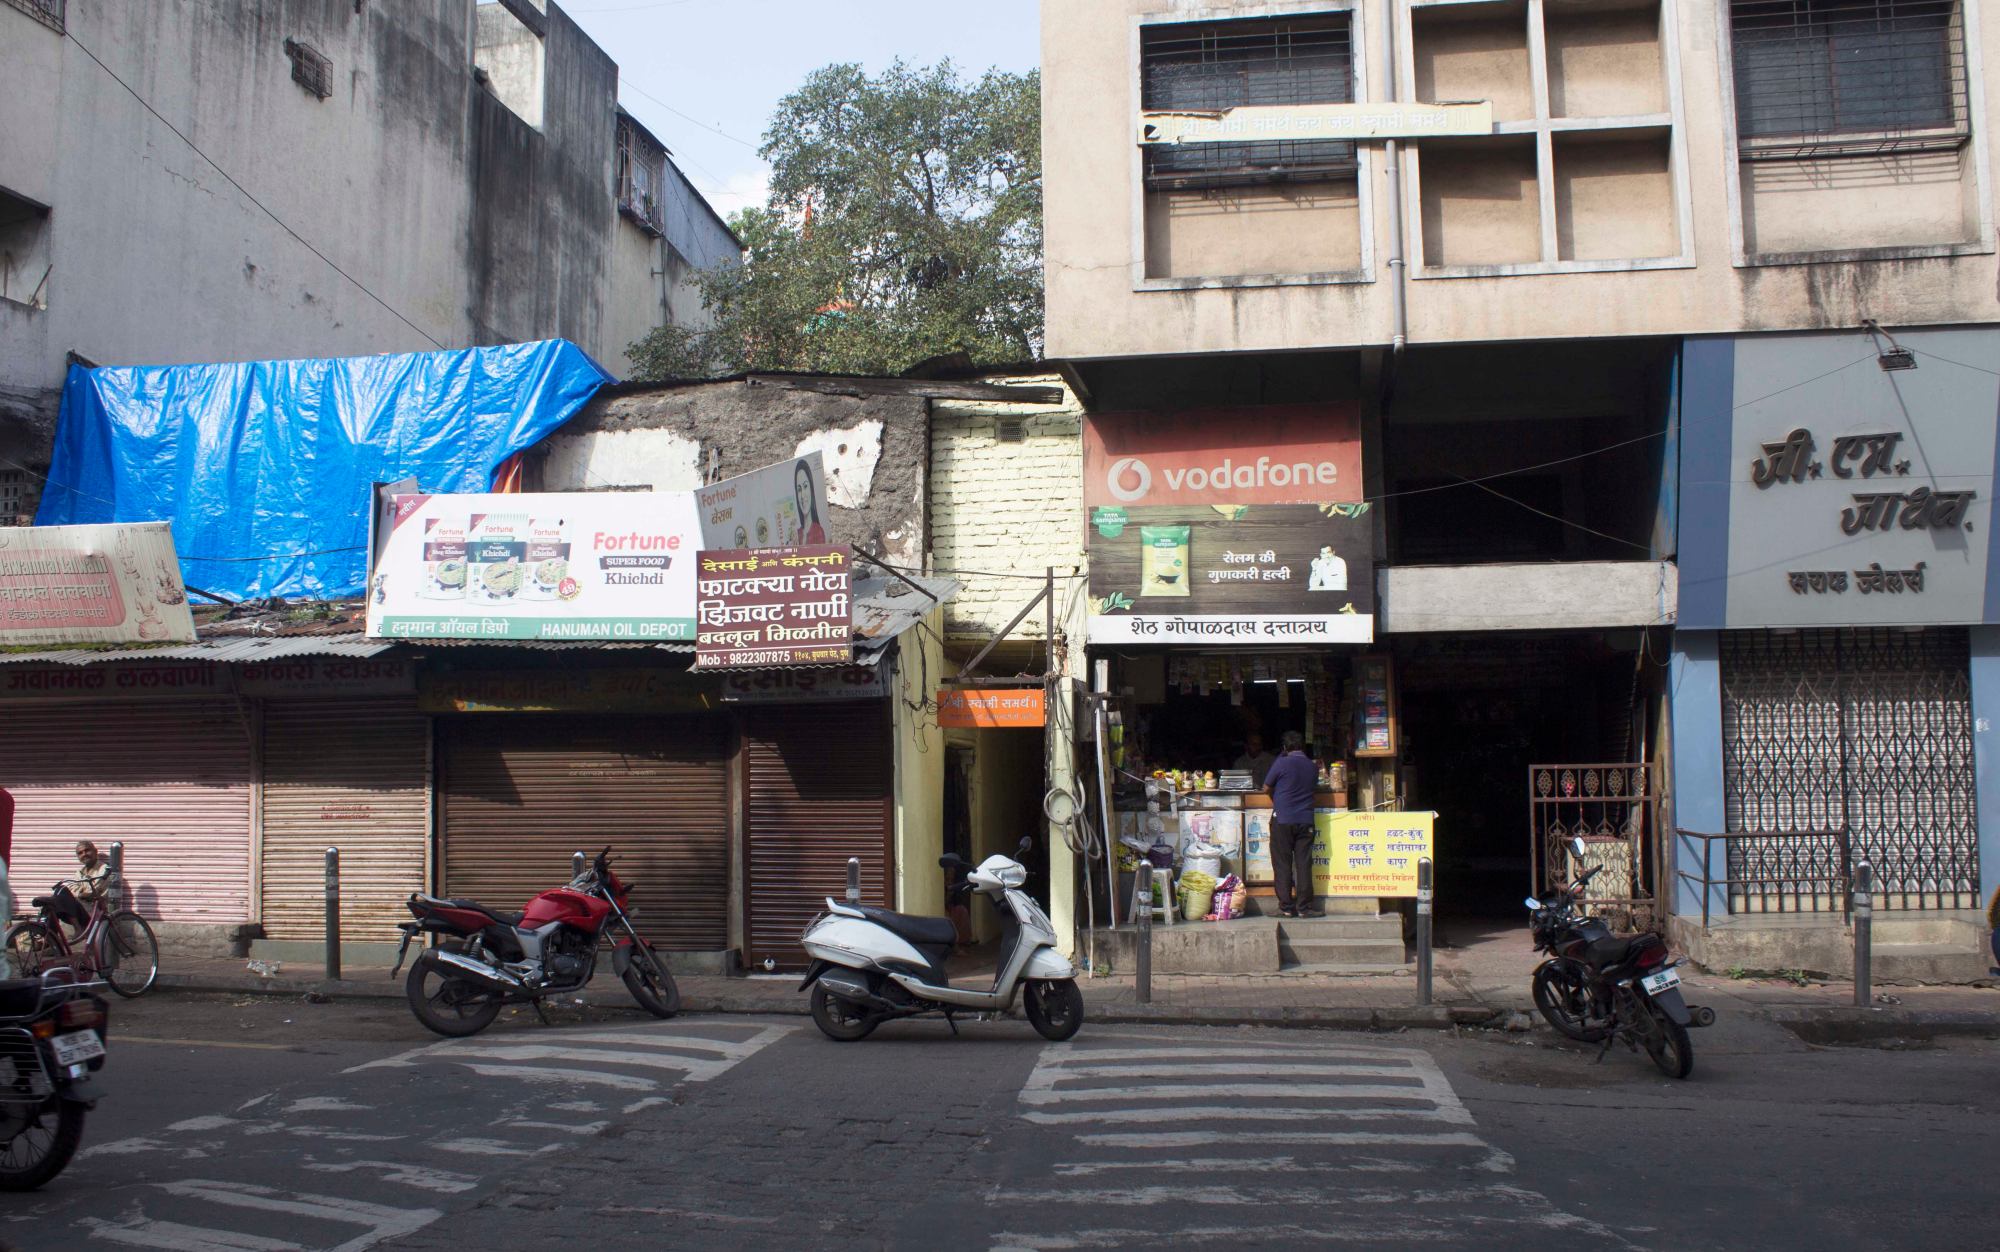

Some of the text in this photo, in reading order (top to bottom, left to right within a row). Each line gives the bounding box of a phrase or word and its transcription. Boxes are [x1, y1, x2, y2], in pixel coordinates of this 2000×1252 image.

[1163, 456, 1337, 491] vodafone
[701, 485, 737, 508] Fortune
[439, 528, 464, 536] Fortune
[485, 525, 514, 533] Fortune
[593, 531, 681, 551] Fortune
[606, 557, 665, 566] SUPER FOOD
[702, 556, 759, 572] देसाई
[781, 552, 845, 567] कंपनी
[1223, 550, 1275, 563] सेलम की
[605, 573, 664, 585] Khichdi
[1208, 566, 1291, 583] गुणकारी हल्दी
[699, 593, 848, 626] झिजवट नाणी
[391, 620, 436, 638] हनुमान
[439, 618, 478, 635] ऑयल
[481, 618, 510, 635] डिपो
[542, 623, 687, 636] HANUMAN OIL DEPOT
[698, 621, 848, 648] बदलून मिळतील
[1131, 616, 1328, 637] शेठ गोपाळदास दत्तात्रय
[698, 654, 721, 666] Mob
[729, 651, 791, 665] 9822307875
[968, 695, 999, 709] स्वामी
